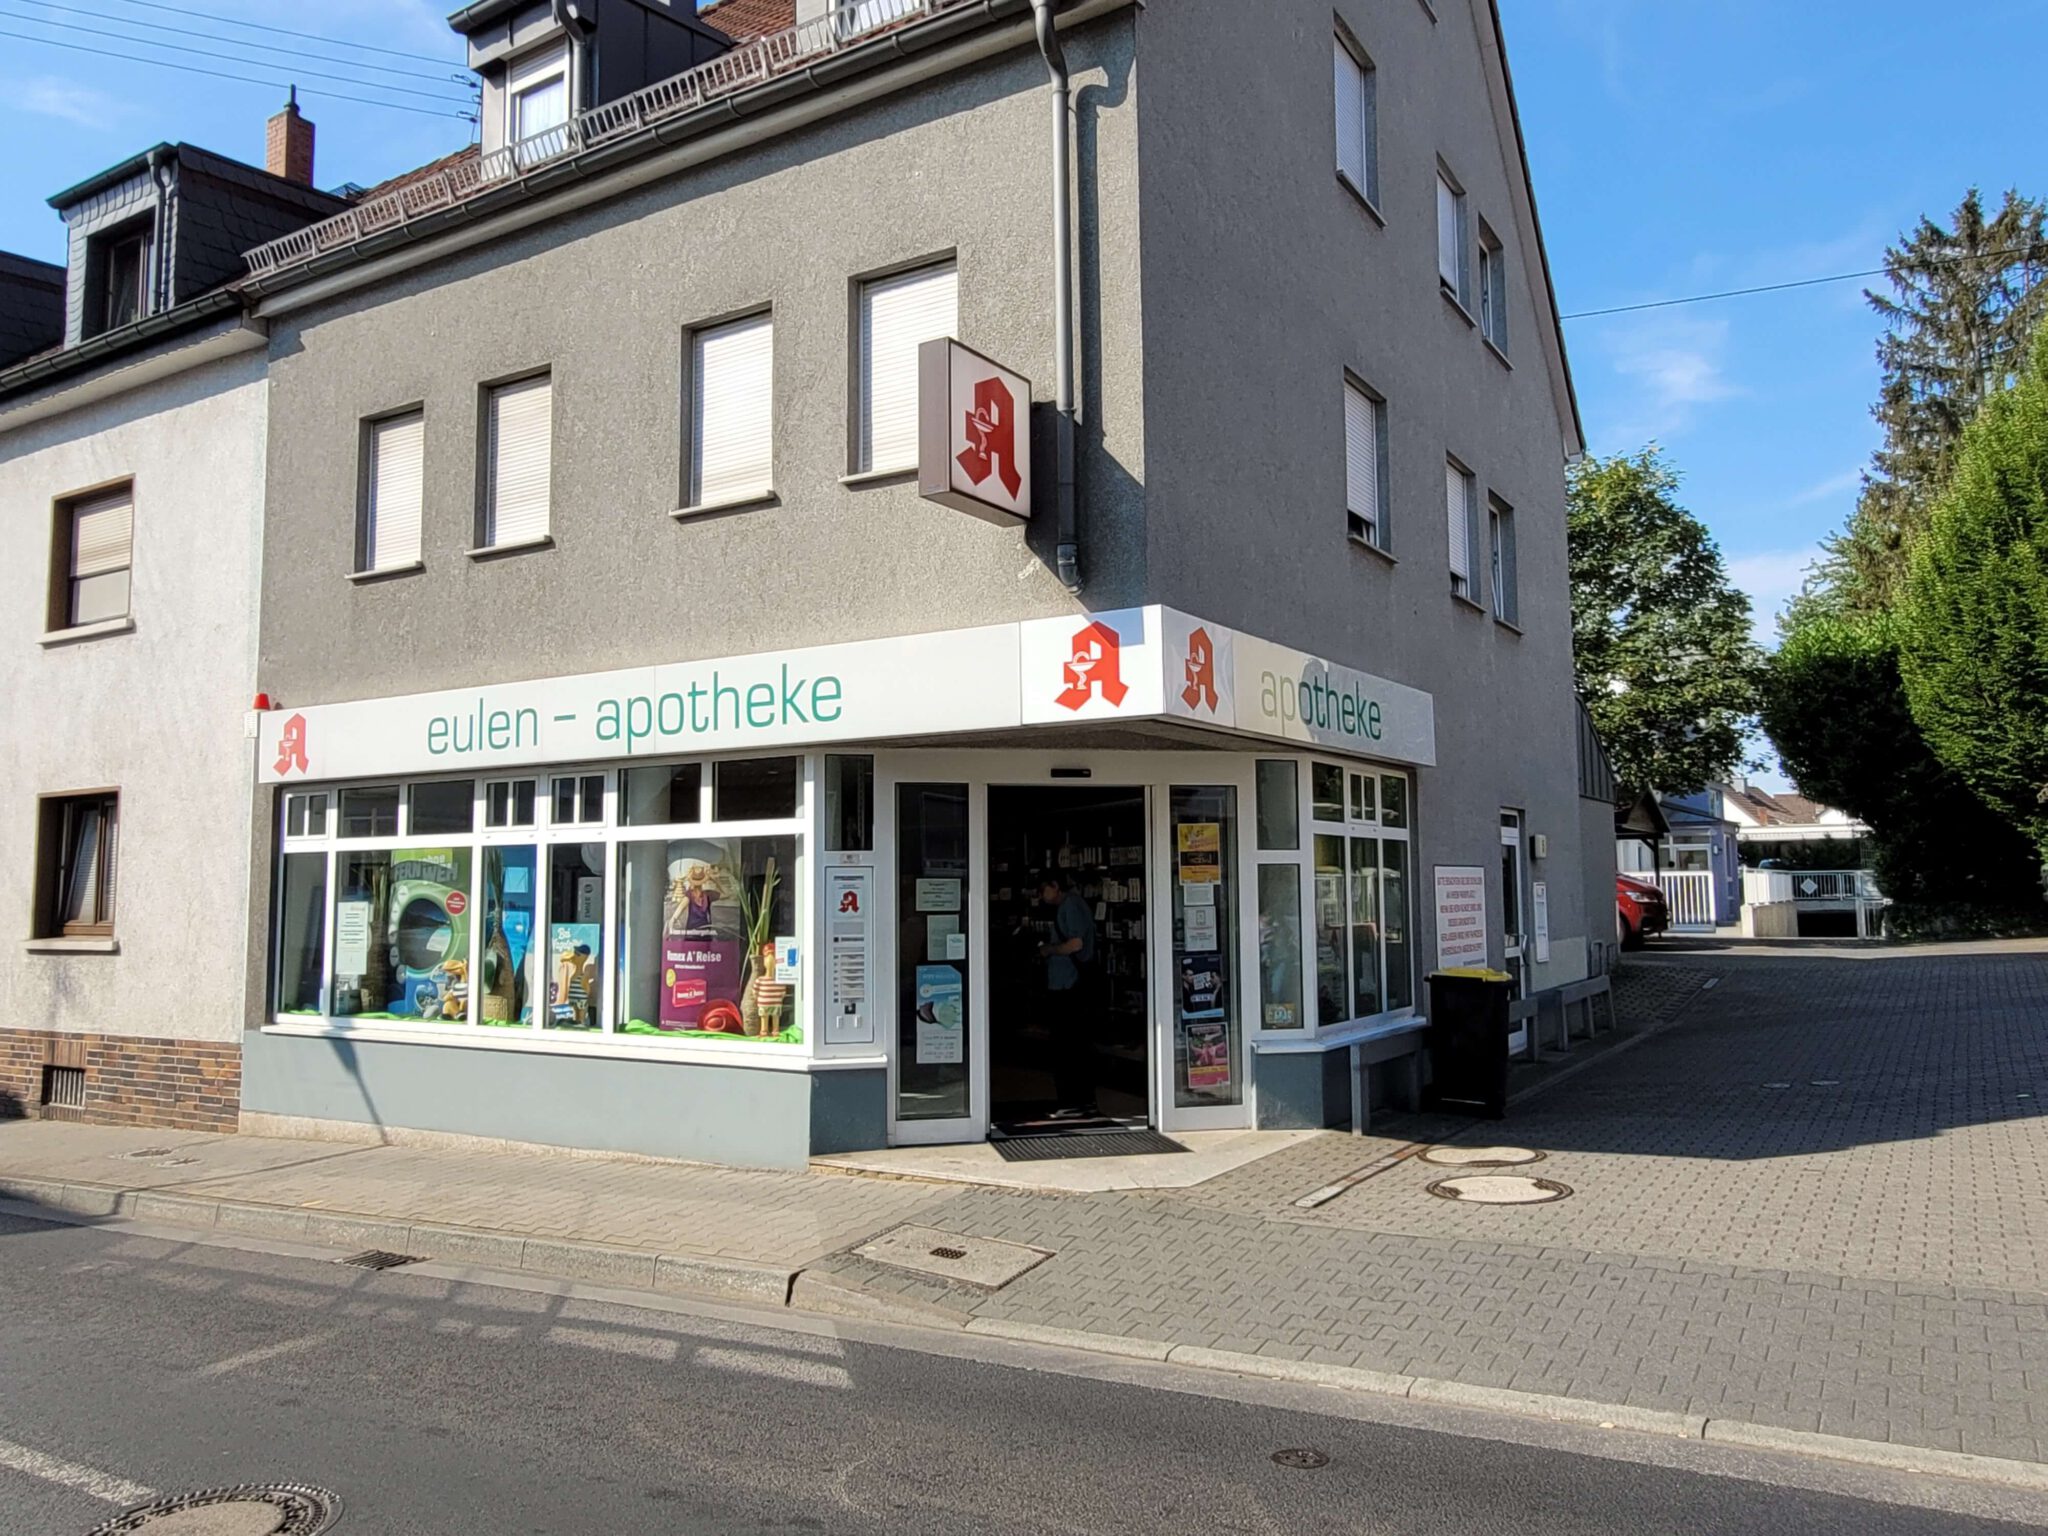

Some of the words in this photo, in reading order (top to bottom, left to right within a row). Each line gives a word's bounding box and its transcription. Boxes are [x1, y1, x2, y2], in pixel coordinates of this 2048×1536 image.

[427, 697, 538, 755] eulen
[595, 663, 842, 754] apotheke
[1260, 669, 1382, 741] apotheke
[696, 951, 722, 962] Reise
